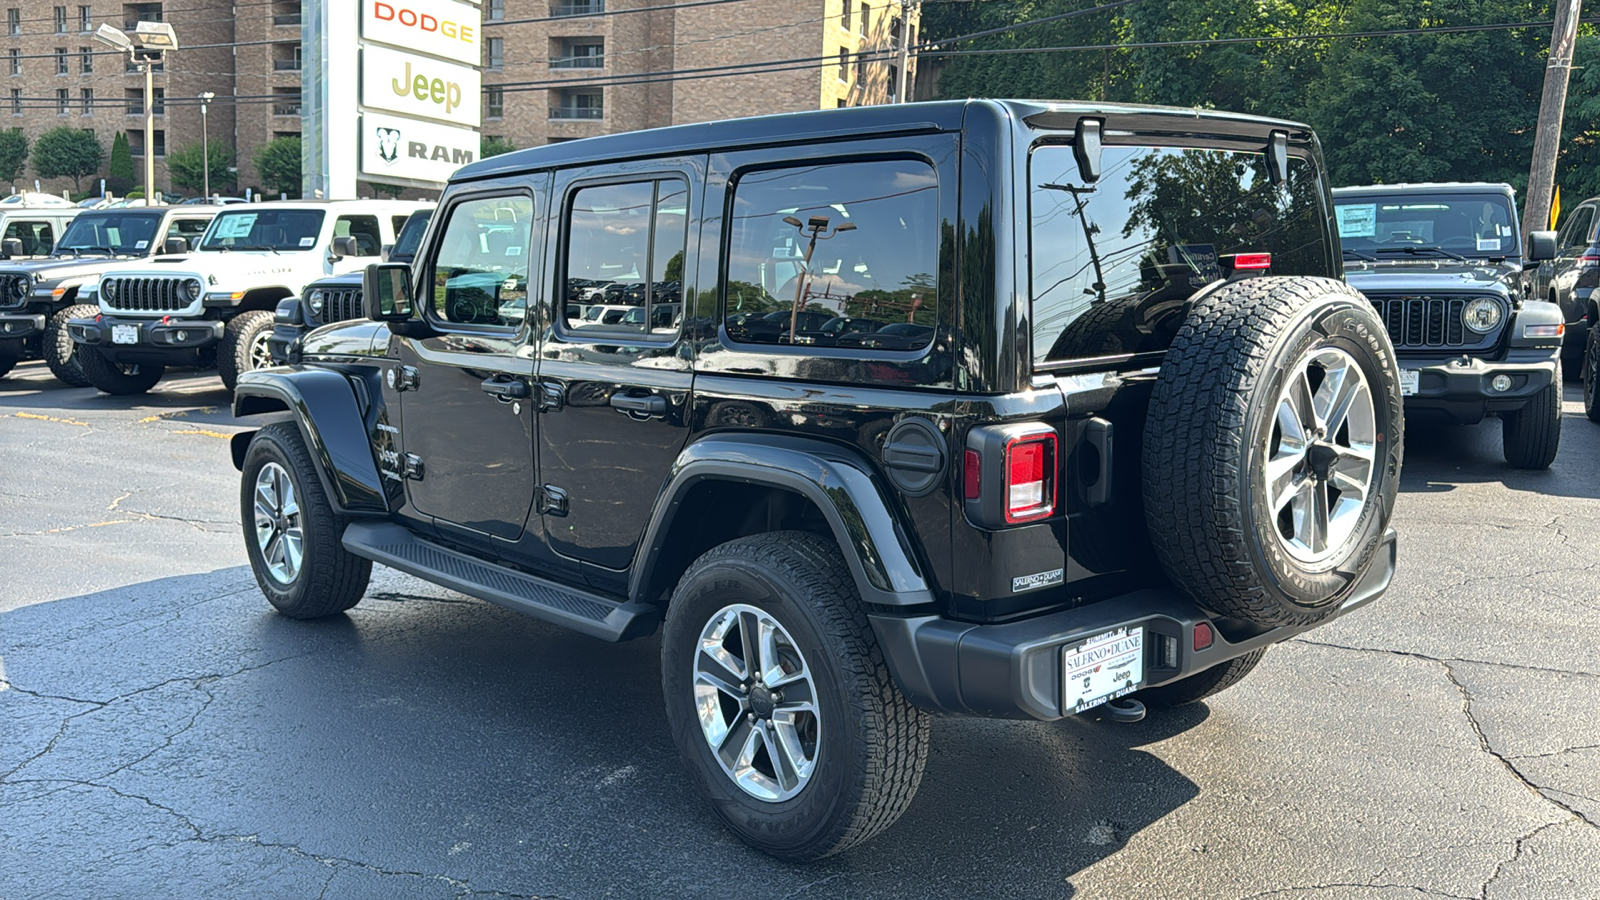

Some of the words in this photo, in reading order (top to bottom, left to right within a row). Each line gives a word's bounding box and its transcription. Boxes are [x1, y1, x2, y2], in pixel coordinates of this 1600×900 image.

[374, 1, 474, 44] DODGE
[392, 61, 462, 114] Jeep
[408, 141, 473, 165] RAM
[1067, 647, 1107, 670] SALERNO
[1111, 635, 1141, 656] DUANE
[1113, 670, 1131, 683] Jeep
[1075, 696, 1107, 713] SALERNO
[1116, 684, 1138, 698] DUANE
